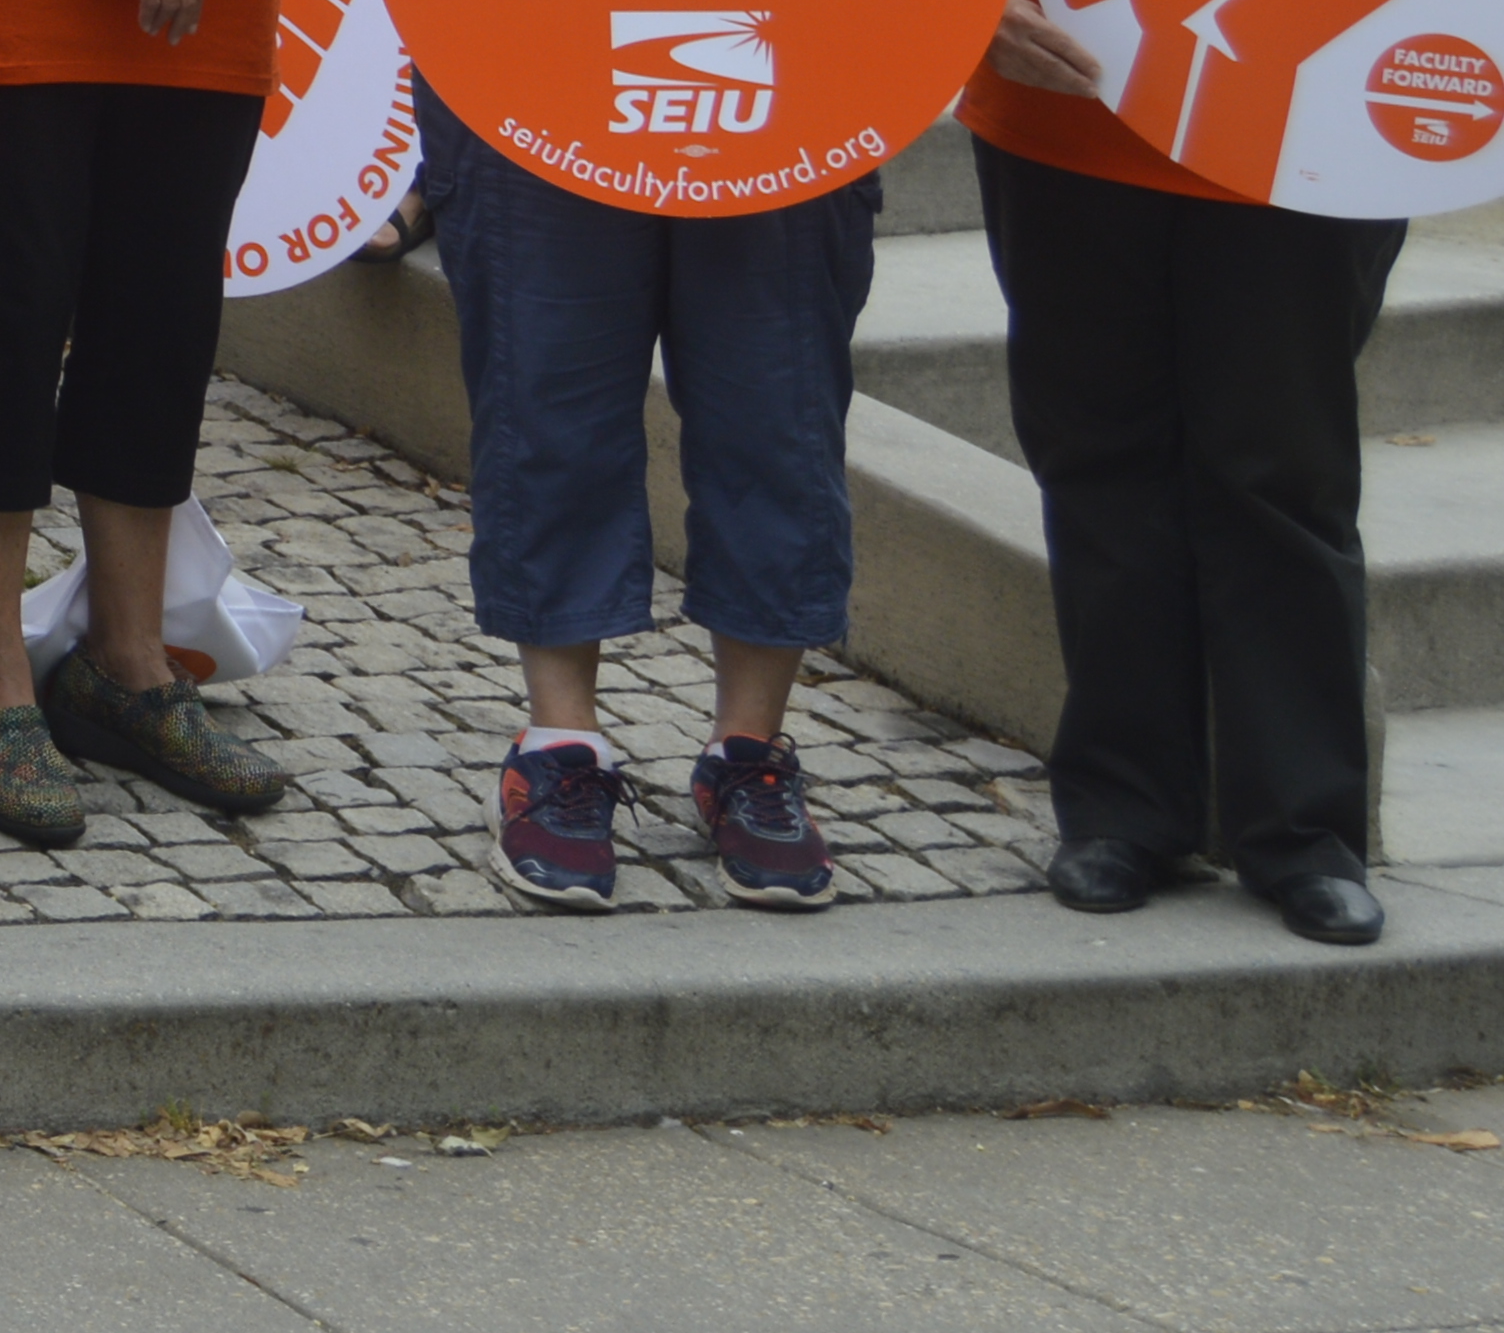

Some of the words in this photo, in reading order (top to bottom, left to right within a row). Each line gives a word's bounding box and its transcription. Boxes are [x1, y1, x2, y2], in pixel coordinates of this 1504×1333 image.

[1394, 48, 1486, 74] FACULTY
[1382, 69, 1493, 96] FORWARD
[609, 89, 773, 134] SEIU
[1411, 133, 1448, 146] SEIU
[498, 115, 886, 205] seiufacultyforward.org
[278, 196, 361, 264] FOR
